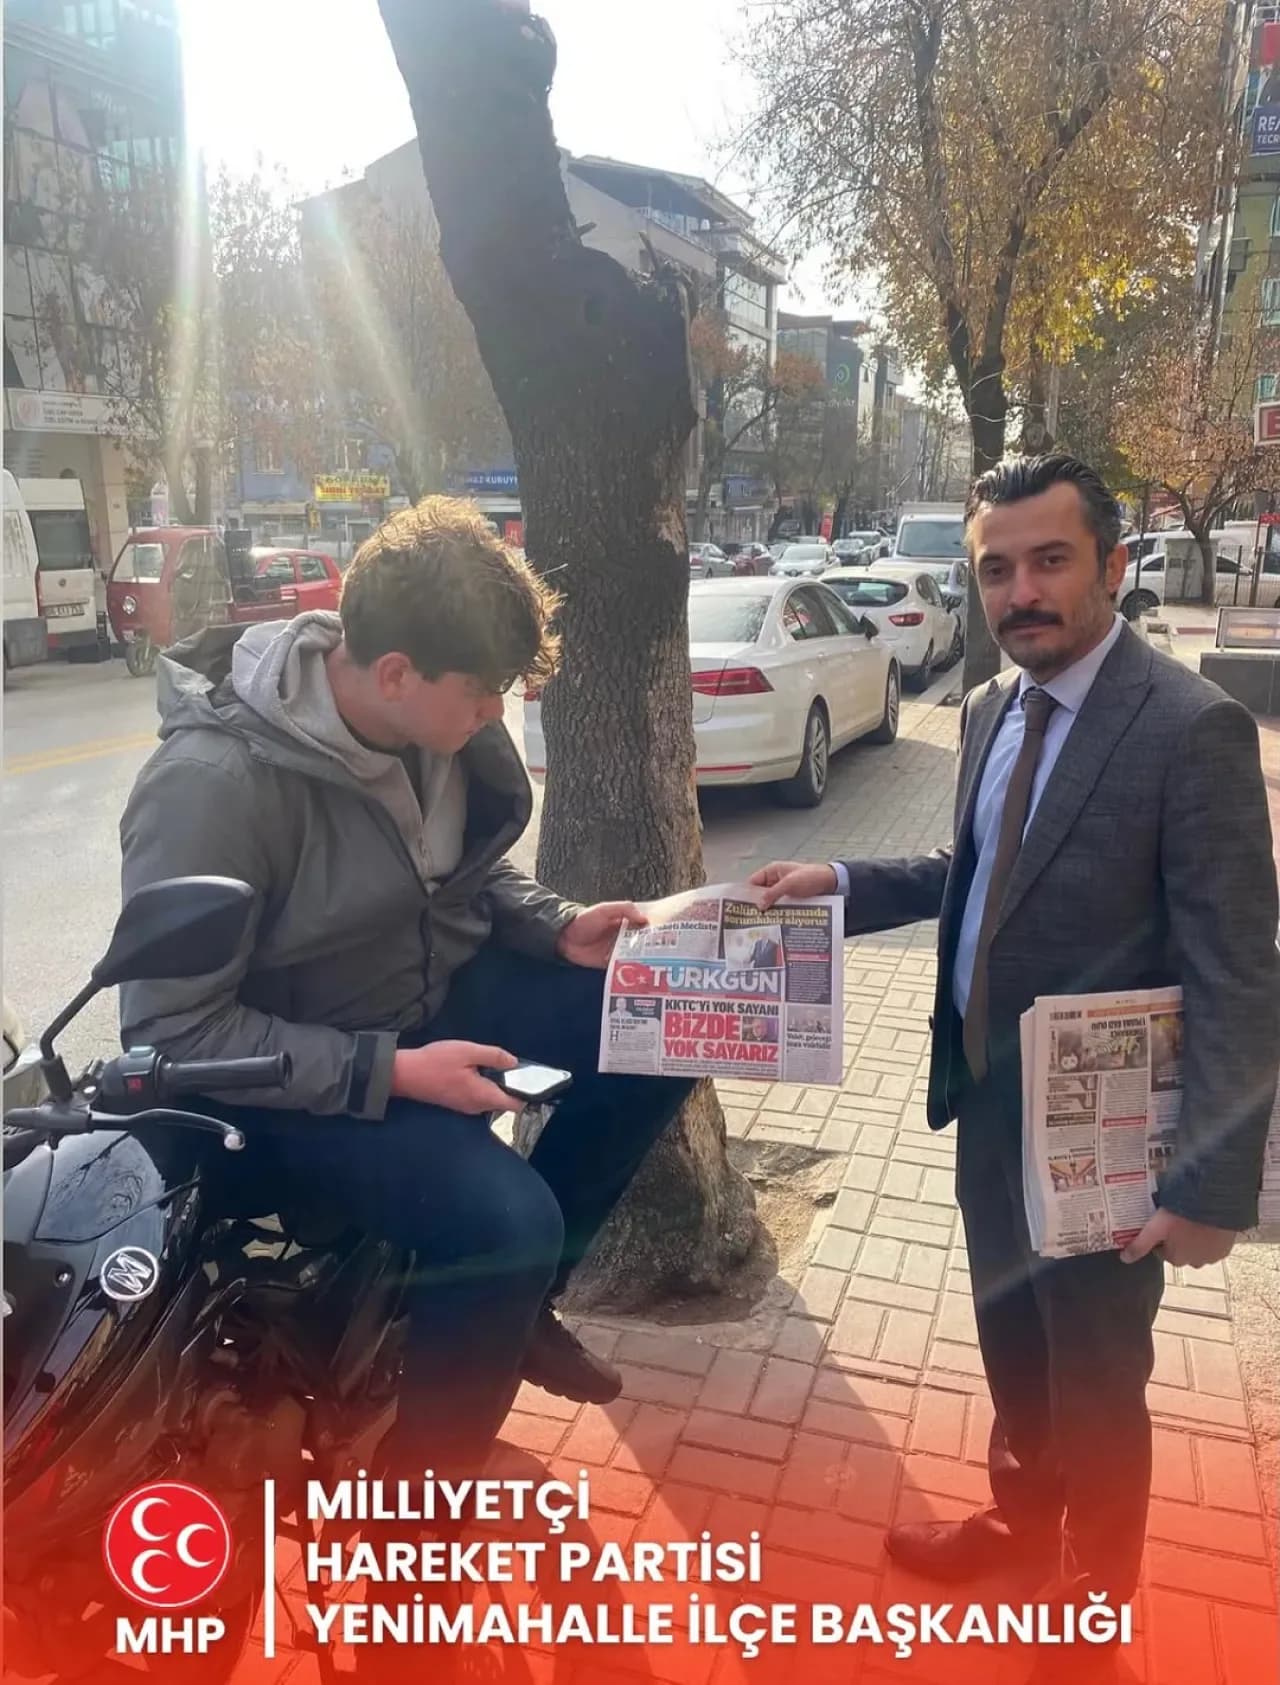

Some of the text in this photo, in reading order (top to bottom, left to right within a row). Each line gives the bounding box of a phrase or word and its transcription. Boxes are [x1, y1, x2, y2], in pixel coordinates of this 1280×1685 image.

[650, 965, 778, 993] TÜRKGÜN
[712, 1002, 735, 1014] YOK
[737, 1003, 779, 1017] SAYANI
[664, 1039, 698, 1058] YOK
[703, 1042, 778, 1063] SAYARIZ
